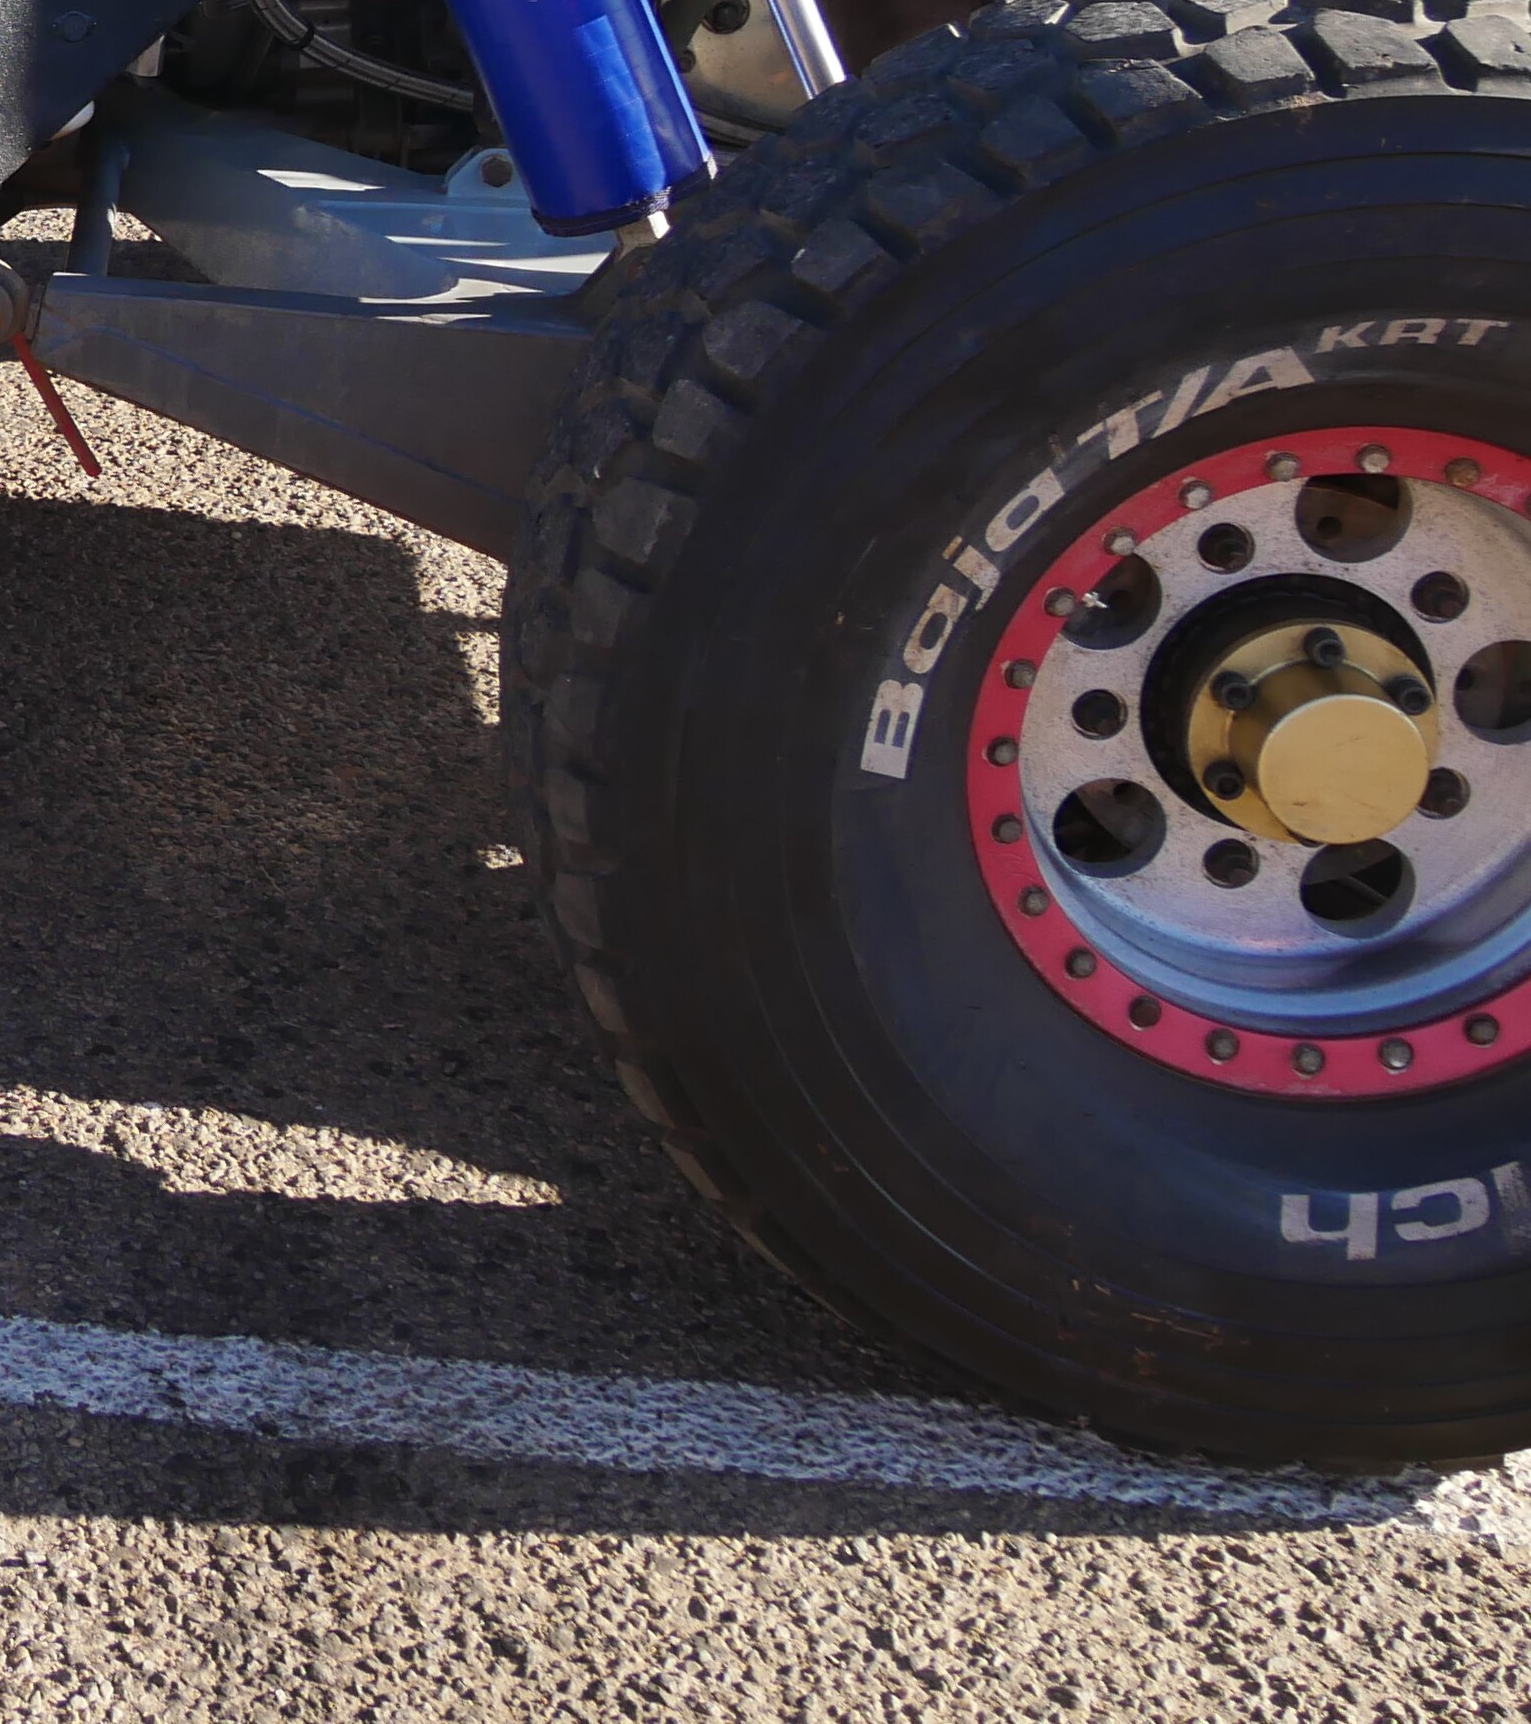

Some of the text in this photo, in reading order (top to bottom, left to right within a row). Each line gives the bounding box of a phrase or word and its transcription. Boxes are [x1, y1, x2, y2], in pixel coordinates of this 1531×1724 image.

[860, 317, 1510, 779] Baja T/A KRT
